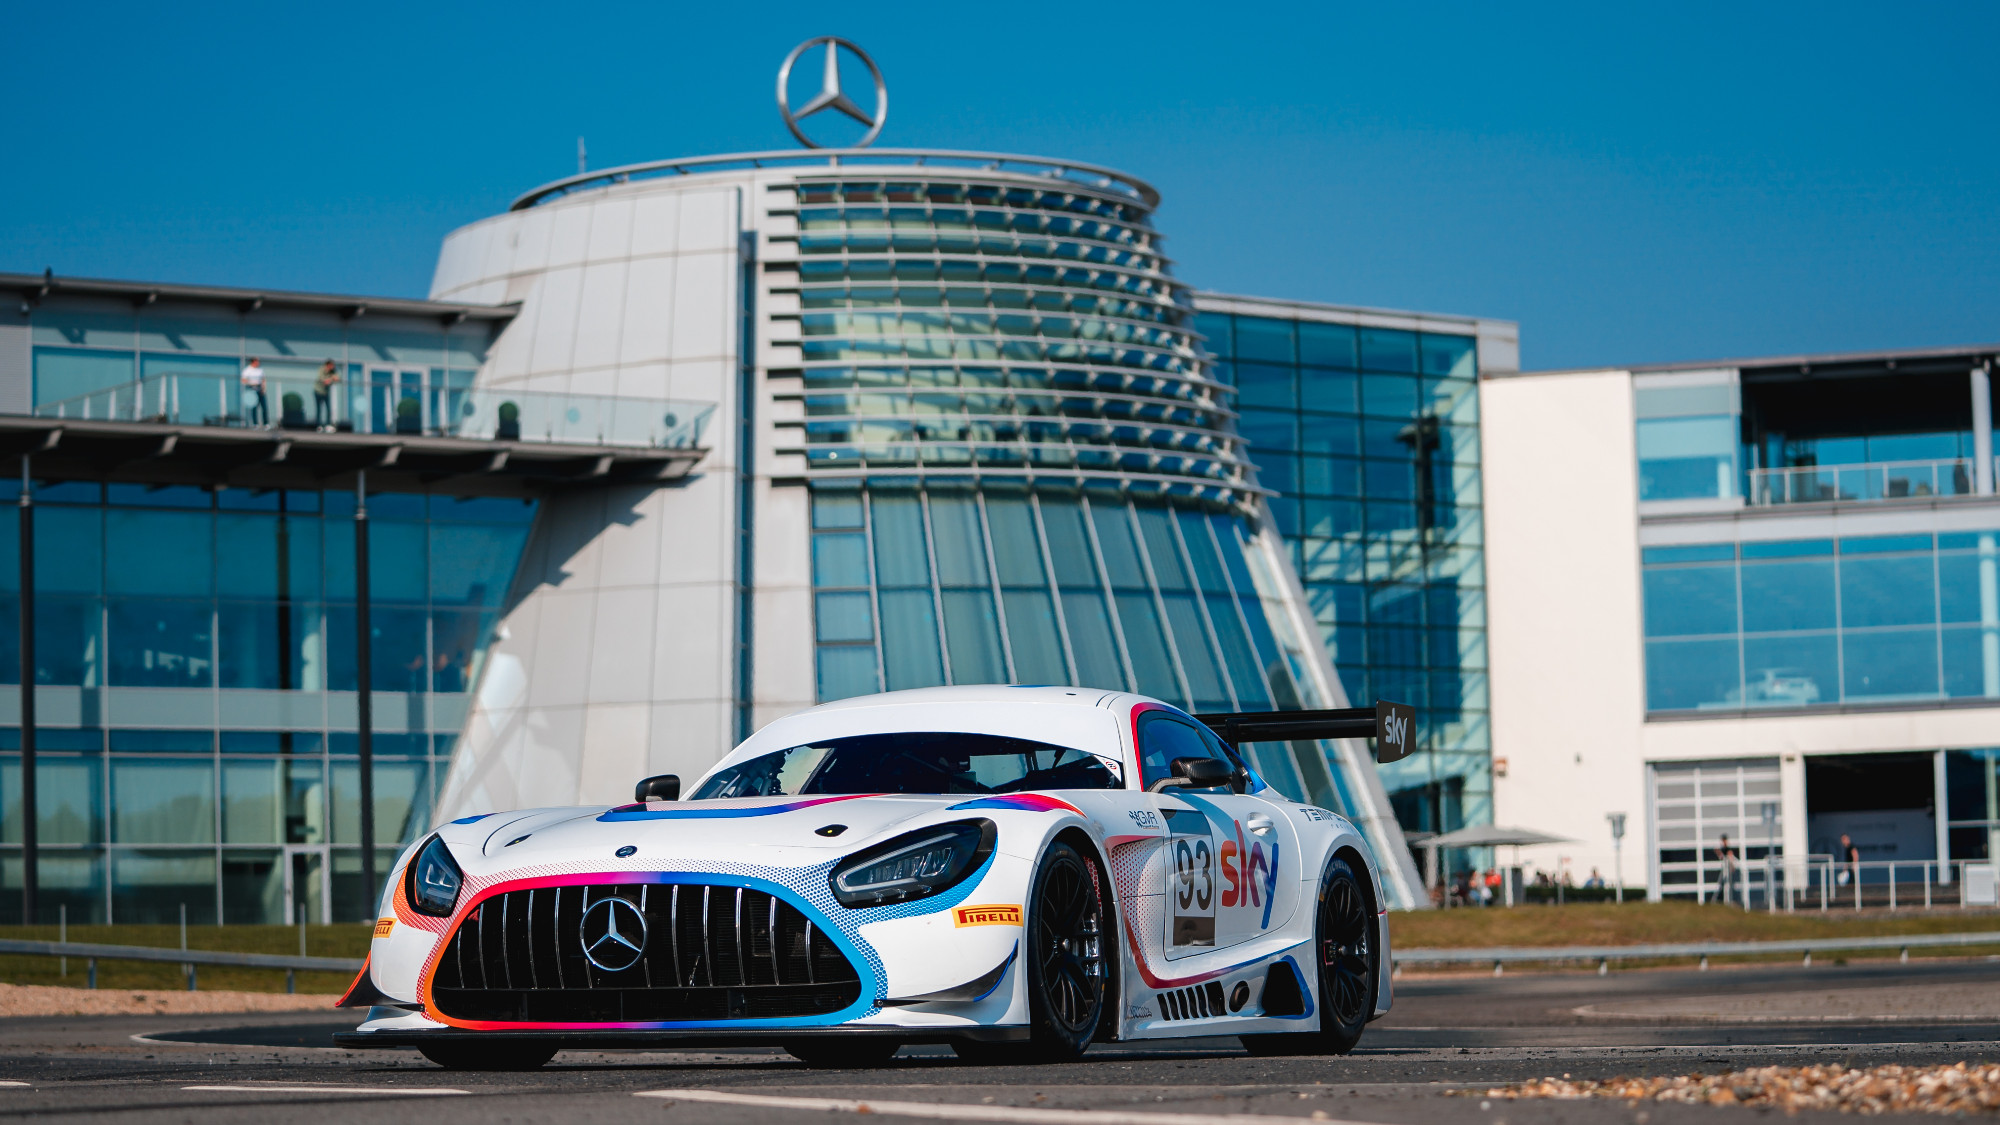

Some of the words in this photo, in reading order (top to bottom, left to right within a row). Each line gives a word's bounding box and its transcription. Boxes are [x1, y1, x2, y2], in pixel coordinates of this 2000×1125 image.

[1385, 707, 1408, 755] sky
[1177, 839, 1212, 910] 93
[1221, 819, 1279, 930] sky
[958, 906, 1019, 924] PIRELLI
